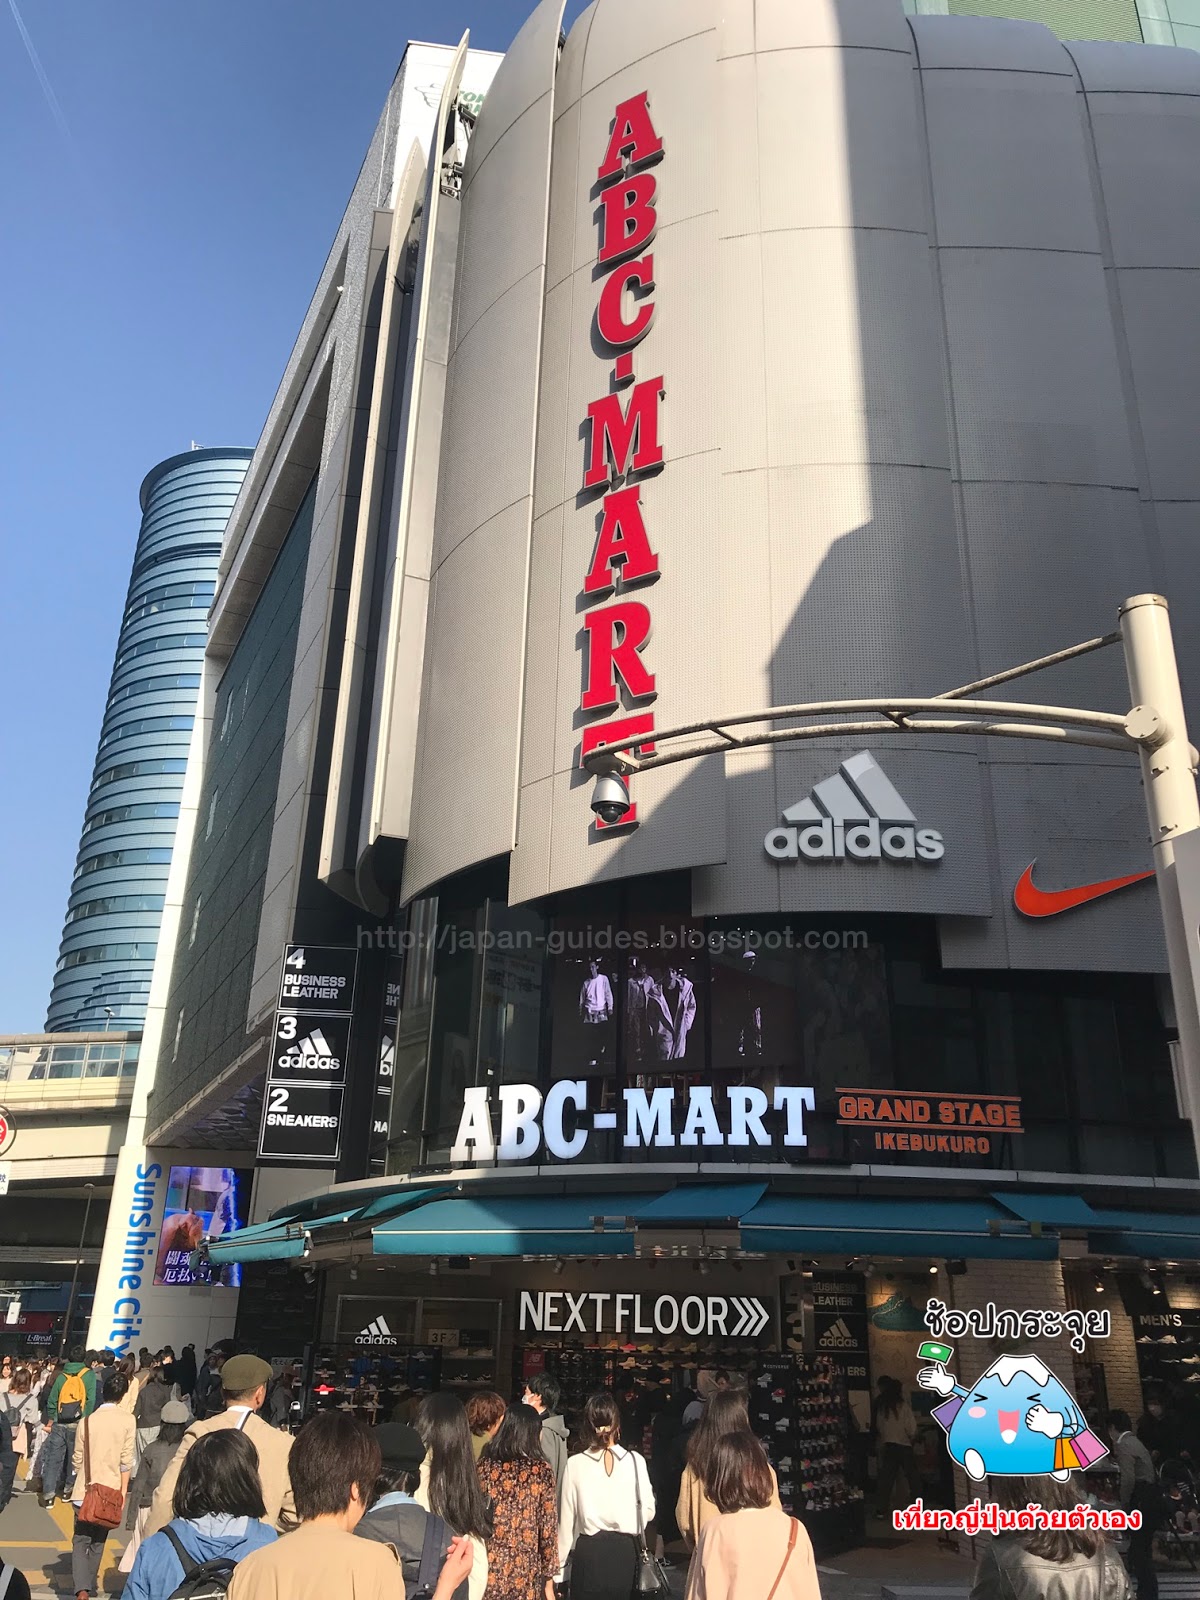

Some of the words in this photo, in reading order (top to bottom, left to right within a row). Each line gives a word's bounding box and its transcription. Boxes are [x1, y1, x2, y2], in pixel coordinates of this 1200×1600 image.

[581, 90, 664, 830] ABC-MART
[763, 817, 945, 861] adidas
[286, 948, 306, 969] 4
[284, 974, 346, 988] BUSINESS
[283, 986, 339, 999] LEATHER
[278, 1016, 297, 1039] 3
[278, 1054, 340, 1070] adidas
[268, 1088, 289, 1112] 2
[267, 1114, 338, 1128] SNEAKERS
[450, 1080, 816, 1162] ABC-MART
[838, 1096, 930, 1123] GRAND
[938, 1101, 1021, 1127] STAGE
[875, 1132, 990, 1154] IKEBUKURO
[118, 1163, 162, 1290] Sunshine
[814, 1296, 853, 1306] LEATHER
[519, 1291, 611, 1332] NEXT
[615, 1293, 732, 1337] FLOOR
[1140, 1314, 1182, 1327] MEN'S
[105, 1298, 142, 1360] City
[354, 1334, 397, 1345] adidas
[819, 1337, 858, 1348] adidas
